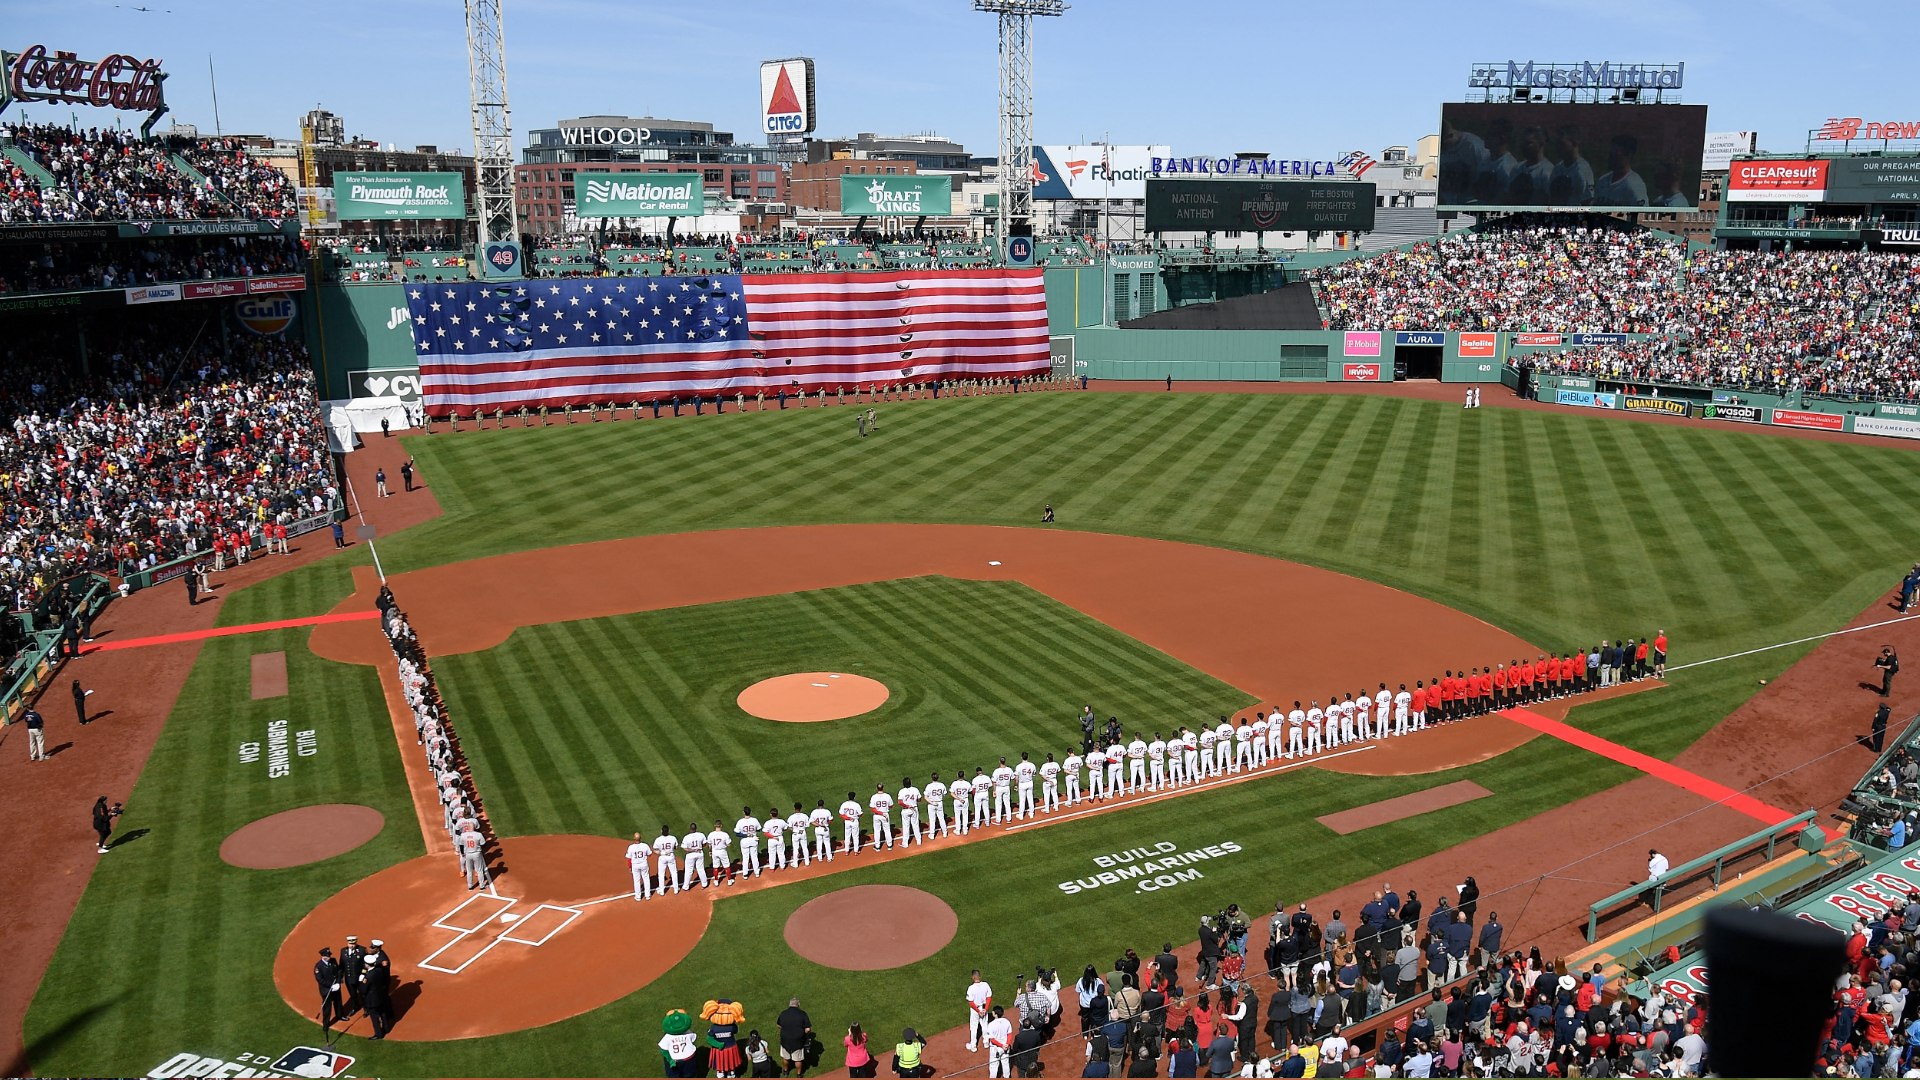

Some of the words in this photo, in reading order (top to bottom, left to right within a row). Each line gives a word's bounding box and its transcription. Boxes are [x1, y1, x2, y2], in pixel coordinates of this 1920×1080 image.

[11, 44, 163, 111] Coca-Cola
[1506, 60, 1685, 89] MassMutual
[767, 115, 802, 131] CITGO
[560, 127, 651, 145] WHOOP
[1865, 121, 1920, 140] new
[1152, 157, 1216, 174] BANK
[1216, 158, 1243, 174] OF
[1248, 159, 1336, 176] AMERICA
[1741, 168, 1817, 178] CLEAResult
[351, 185, 412, 200] Plymouth
[415, 185, 448, 199] Rock
[610, 182, 691, 201] National
[869, 190, 922, 204] DRAFT
[1310, 190, 1325, 198] THE
[1326, 190, 1354, 198] BOSTON
[1172, 194, 1219, 204] NATIONAL
[640, 202, 655, 210] Car
[659, 202, 688, 210] Rental
[876, 202, 921, 212] KINGS
[1242, 201, 1275, 212] OPENING
[1275, 201, 1289, 212] DAY
[1176, 208, 1214, 219] ANTHEM
[1314, 214, 1348, 222] QUARTET
[231, 224, 258, 232] MATTER
[250, 282, 278, 290] Safelite
[148, 289, 176, 298] AMAZING
[238, 301, 293, 318] Gulf
[1534, 336, 1559, 345] TICKET
[1559, 392, 1589, 403] jetBlue
[1626, 399, 1663, 409] GRANITE
[1666, 401, 1685, 412] CITY
[1716, 407, 1755, 417] wasabi
[156, 564, 188, 580] Safelite
[296, 730, 317, 756] BUILD
[268, 720, 290, 778] SUBMARINES
[466, 840, 475, 848] 18
[1093, 842, 1177, 868] BUILD
[1058, 842, 1242, 894] SUBMARINES
[672, 1043, 687, 1054] 97
[1519, 1047, 1531, 1056] 24
